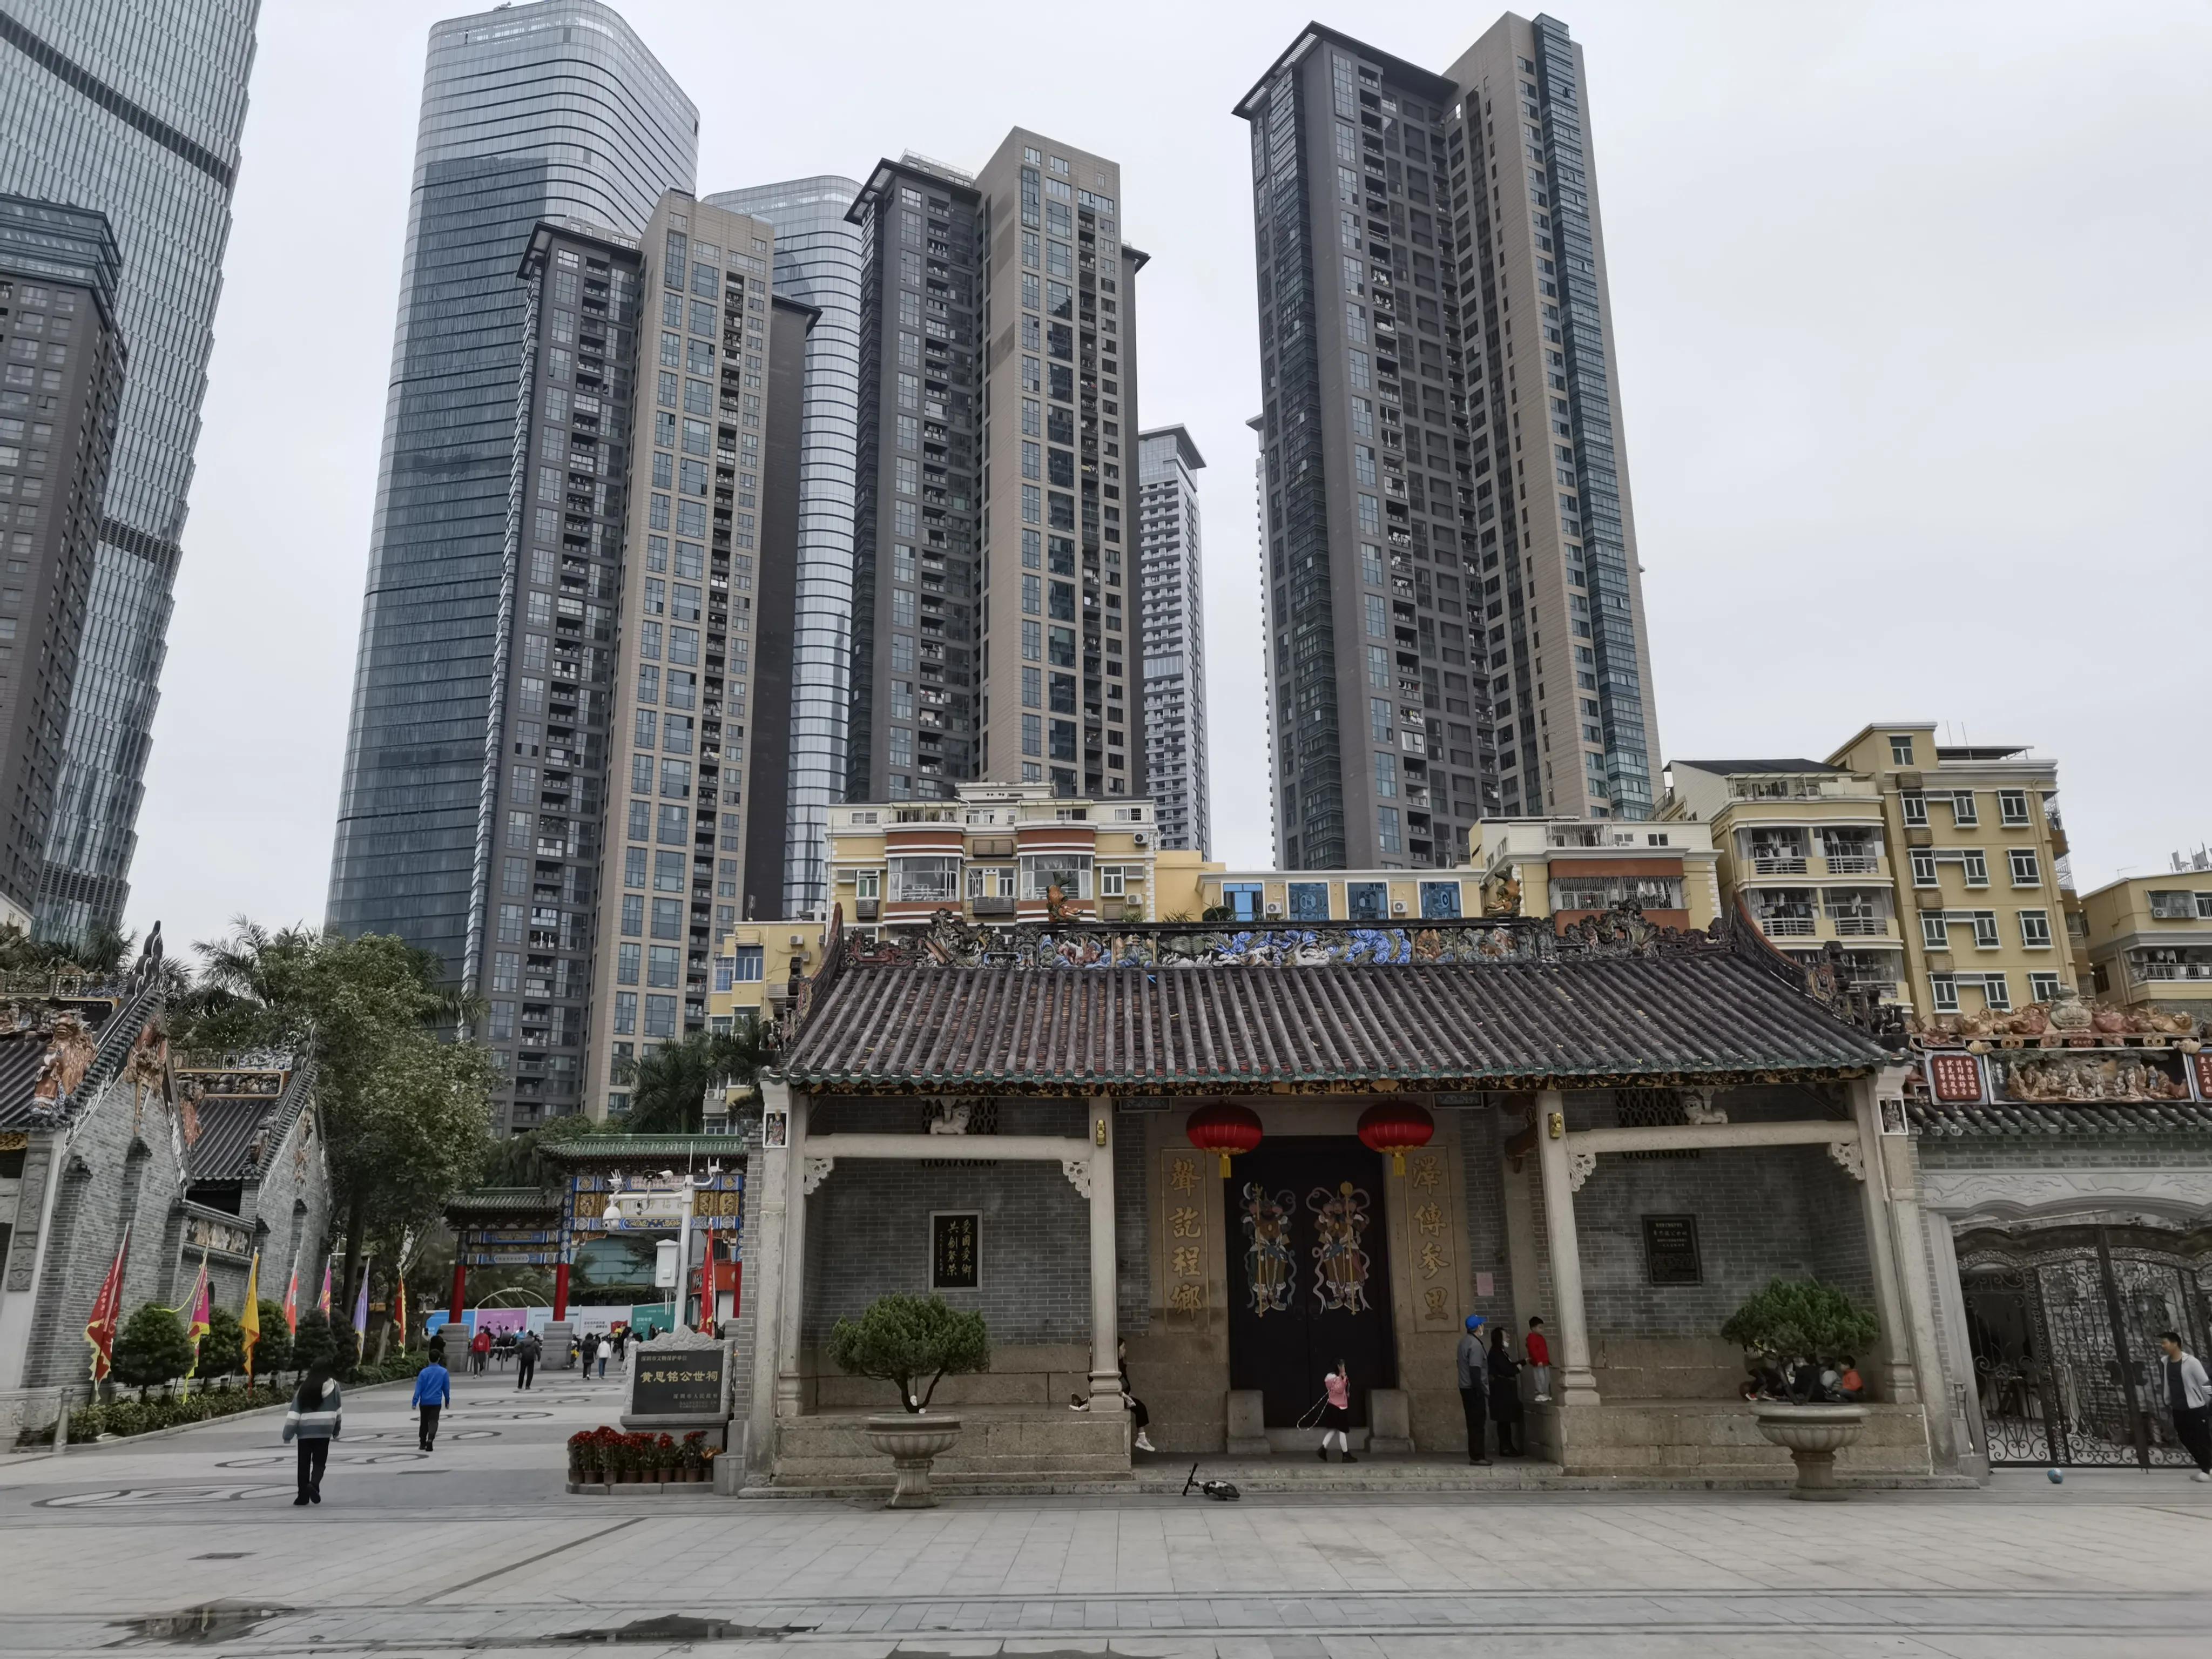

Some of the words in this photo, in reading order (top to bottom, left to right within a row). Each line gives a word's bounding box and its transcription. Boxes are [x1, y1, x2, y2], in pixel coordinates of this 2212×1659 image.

[640, 1370, 718, 1383] 黄思铭公世祠
